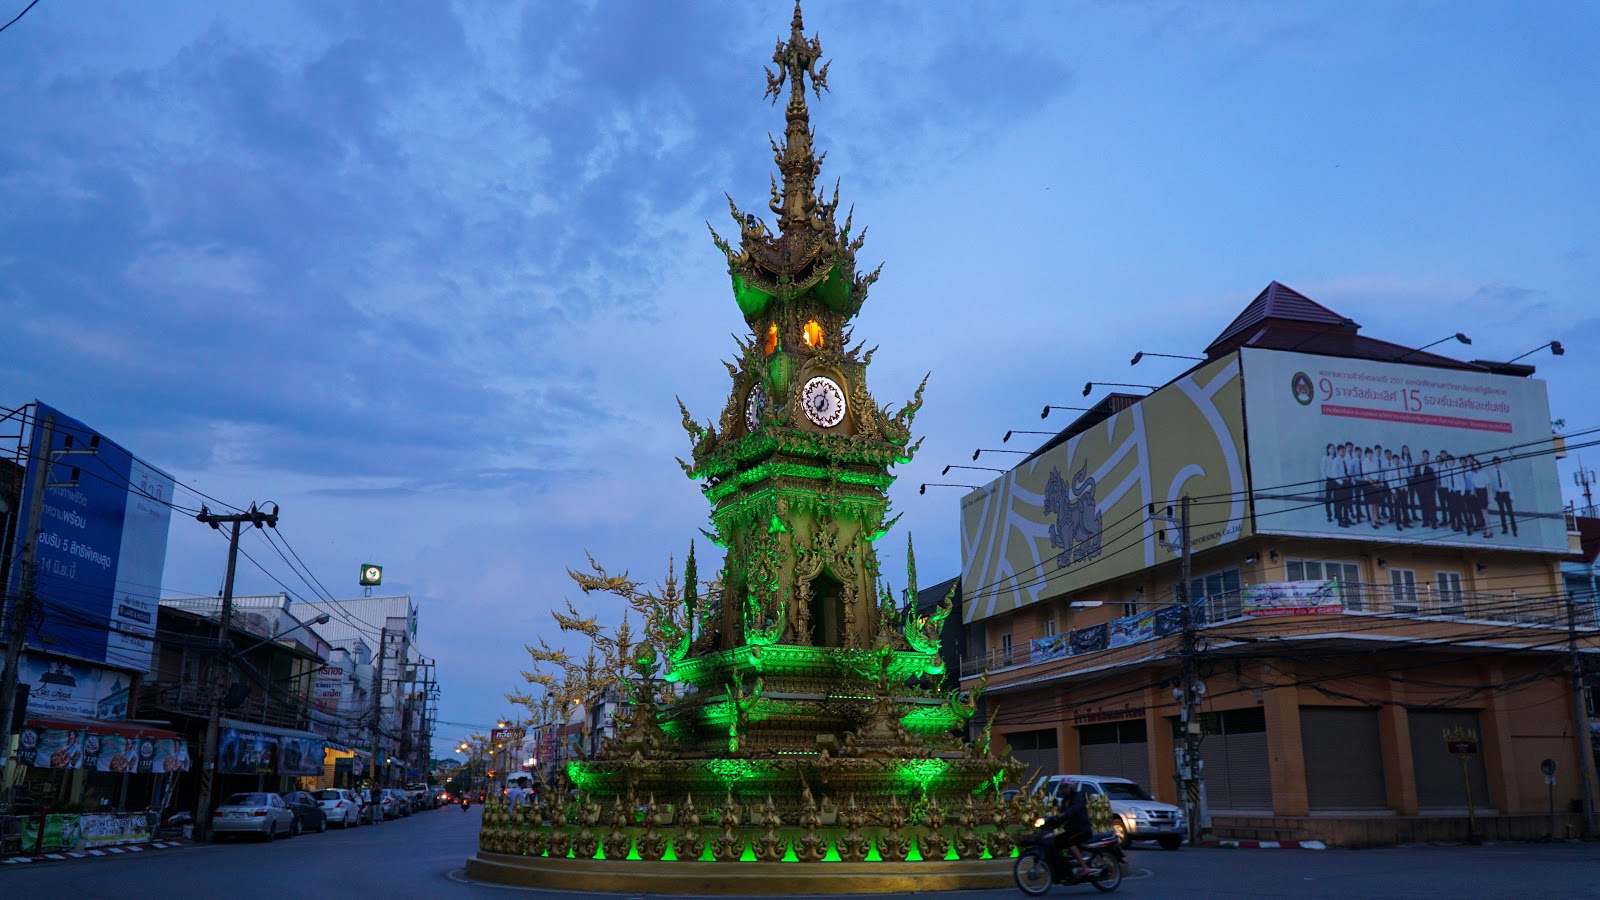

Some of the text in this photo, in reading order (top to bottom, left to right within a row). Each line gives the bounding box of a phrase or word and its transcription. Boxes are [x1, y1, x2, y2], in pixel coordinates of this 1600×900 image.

[1319, 378, 1334, 402] 9
[1400, 388, 1423, 412] 15
[62, 538, 69, 552] 5
